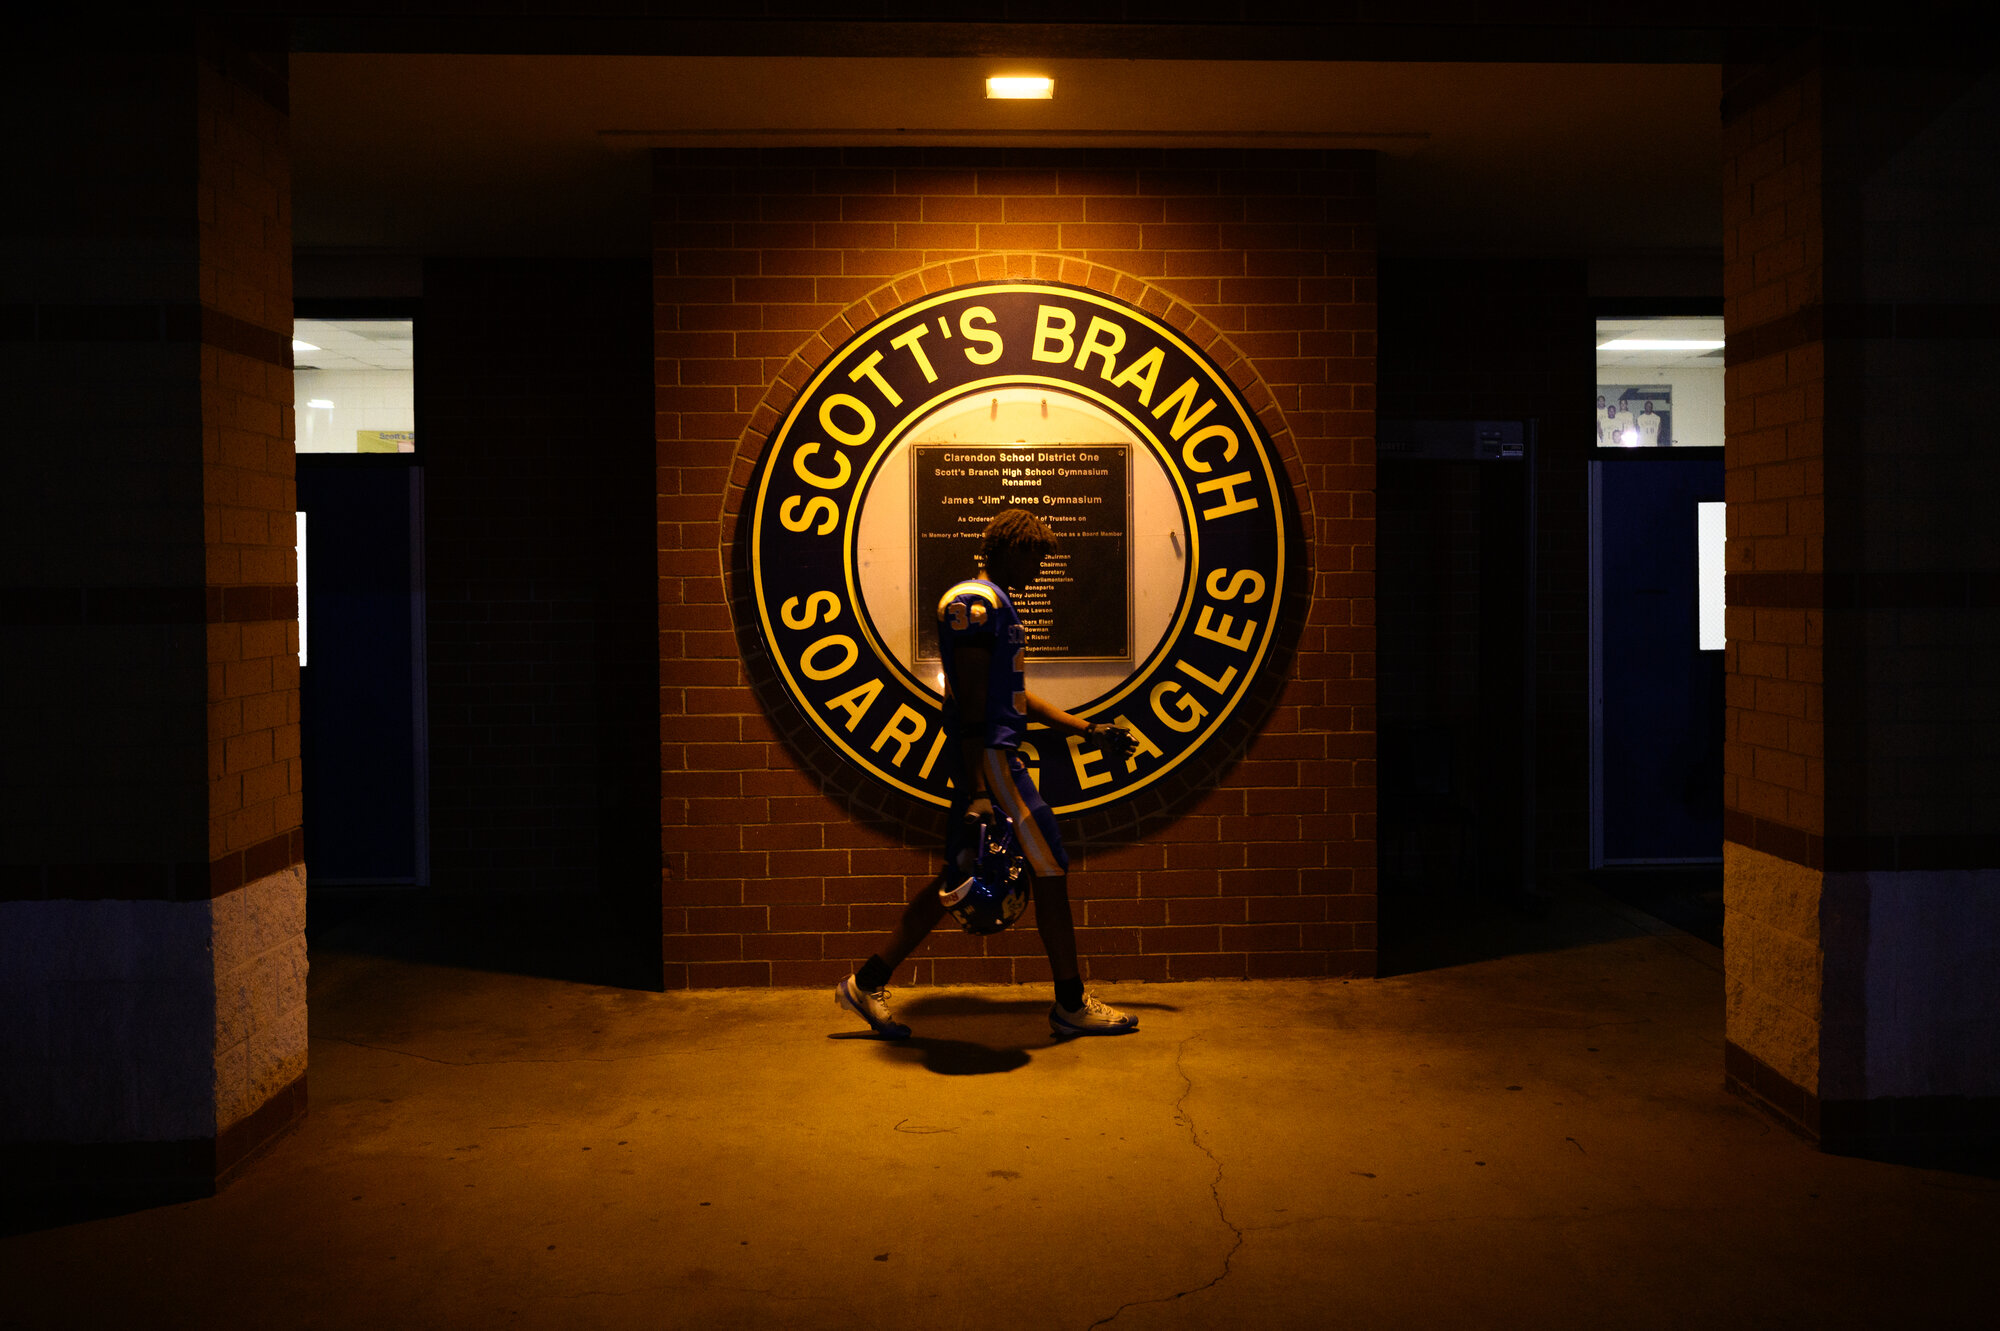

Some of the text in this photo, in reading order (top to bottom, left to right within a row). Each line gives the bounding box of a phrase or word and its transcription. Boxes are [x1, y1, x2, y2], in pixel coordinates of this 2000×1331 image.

[779, 304, 1260, 536] SCOTT'S BRANCH
[943, 453, 1100, 463] Clarendon School District One
[934, 468, 1109, 478] Scott's Branch High School Gymnasium
[1001, 478, 1042, 487] Renamed
[941, 495, 975, 505] James
[1008, 495, 1039, 505] Jones
[1042, 495, 1103, 506] Gymnasium
[957, 515, 967, 523] As
[1040, 515, 1048, 523] of
[1048, 515, 1077, 523] Trustees
[921, 531, 928, 539] In
[929, 531, 952, 540] Memory
[952, 531, 960, 539] of
[1082, 530, 1099, 538] Board
[1100, 530, 1123, 538] Member
[780, 589, 1041, 793] SOARIG
